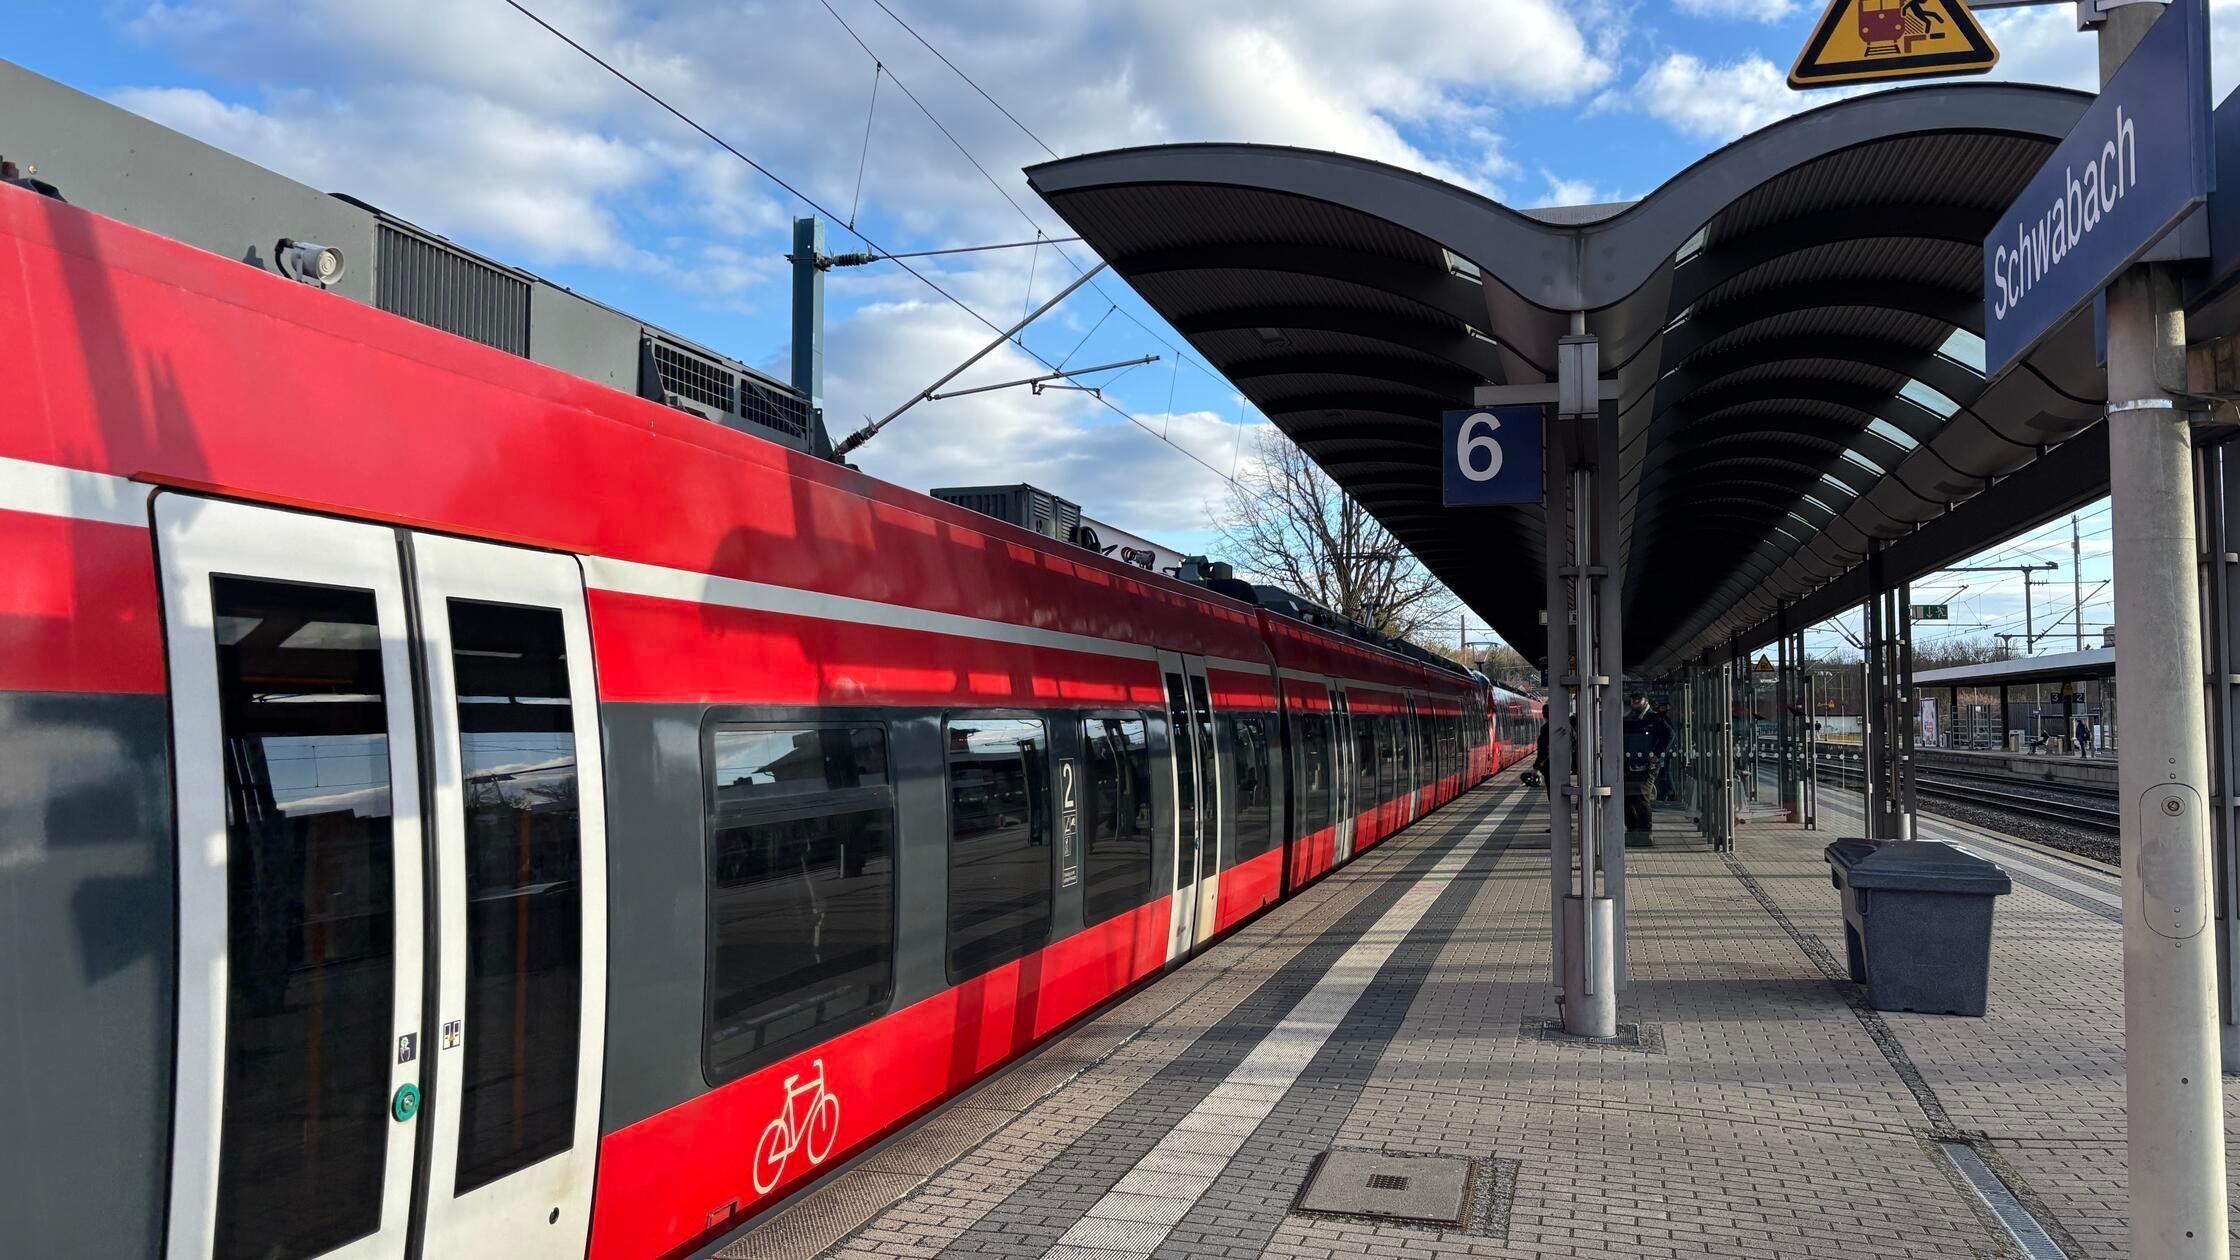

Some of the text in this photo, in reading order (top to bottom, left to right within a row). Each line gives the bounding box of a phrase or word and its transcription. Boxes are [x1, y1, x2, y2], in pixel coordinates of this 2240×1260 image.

[1994, 105, 2137, 321] Schwabach
[1457, 412, 1503, 482] 6
[2052, 693, 2059, 702] 3
[2076, 693, 2084, 702] 2
[1063, 763, 1074, 808] 2
